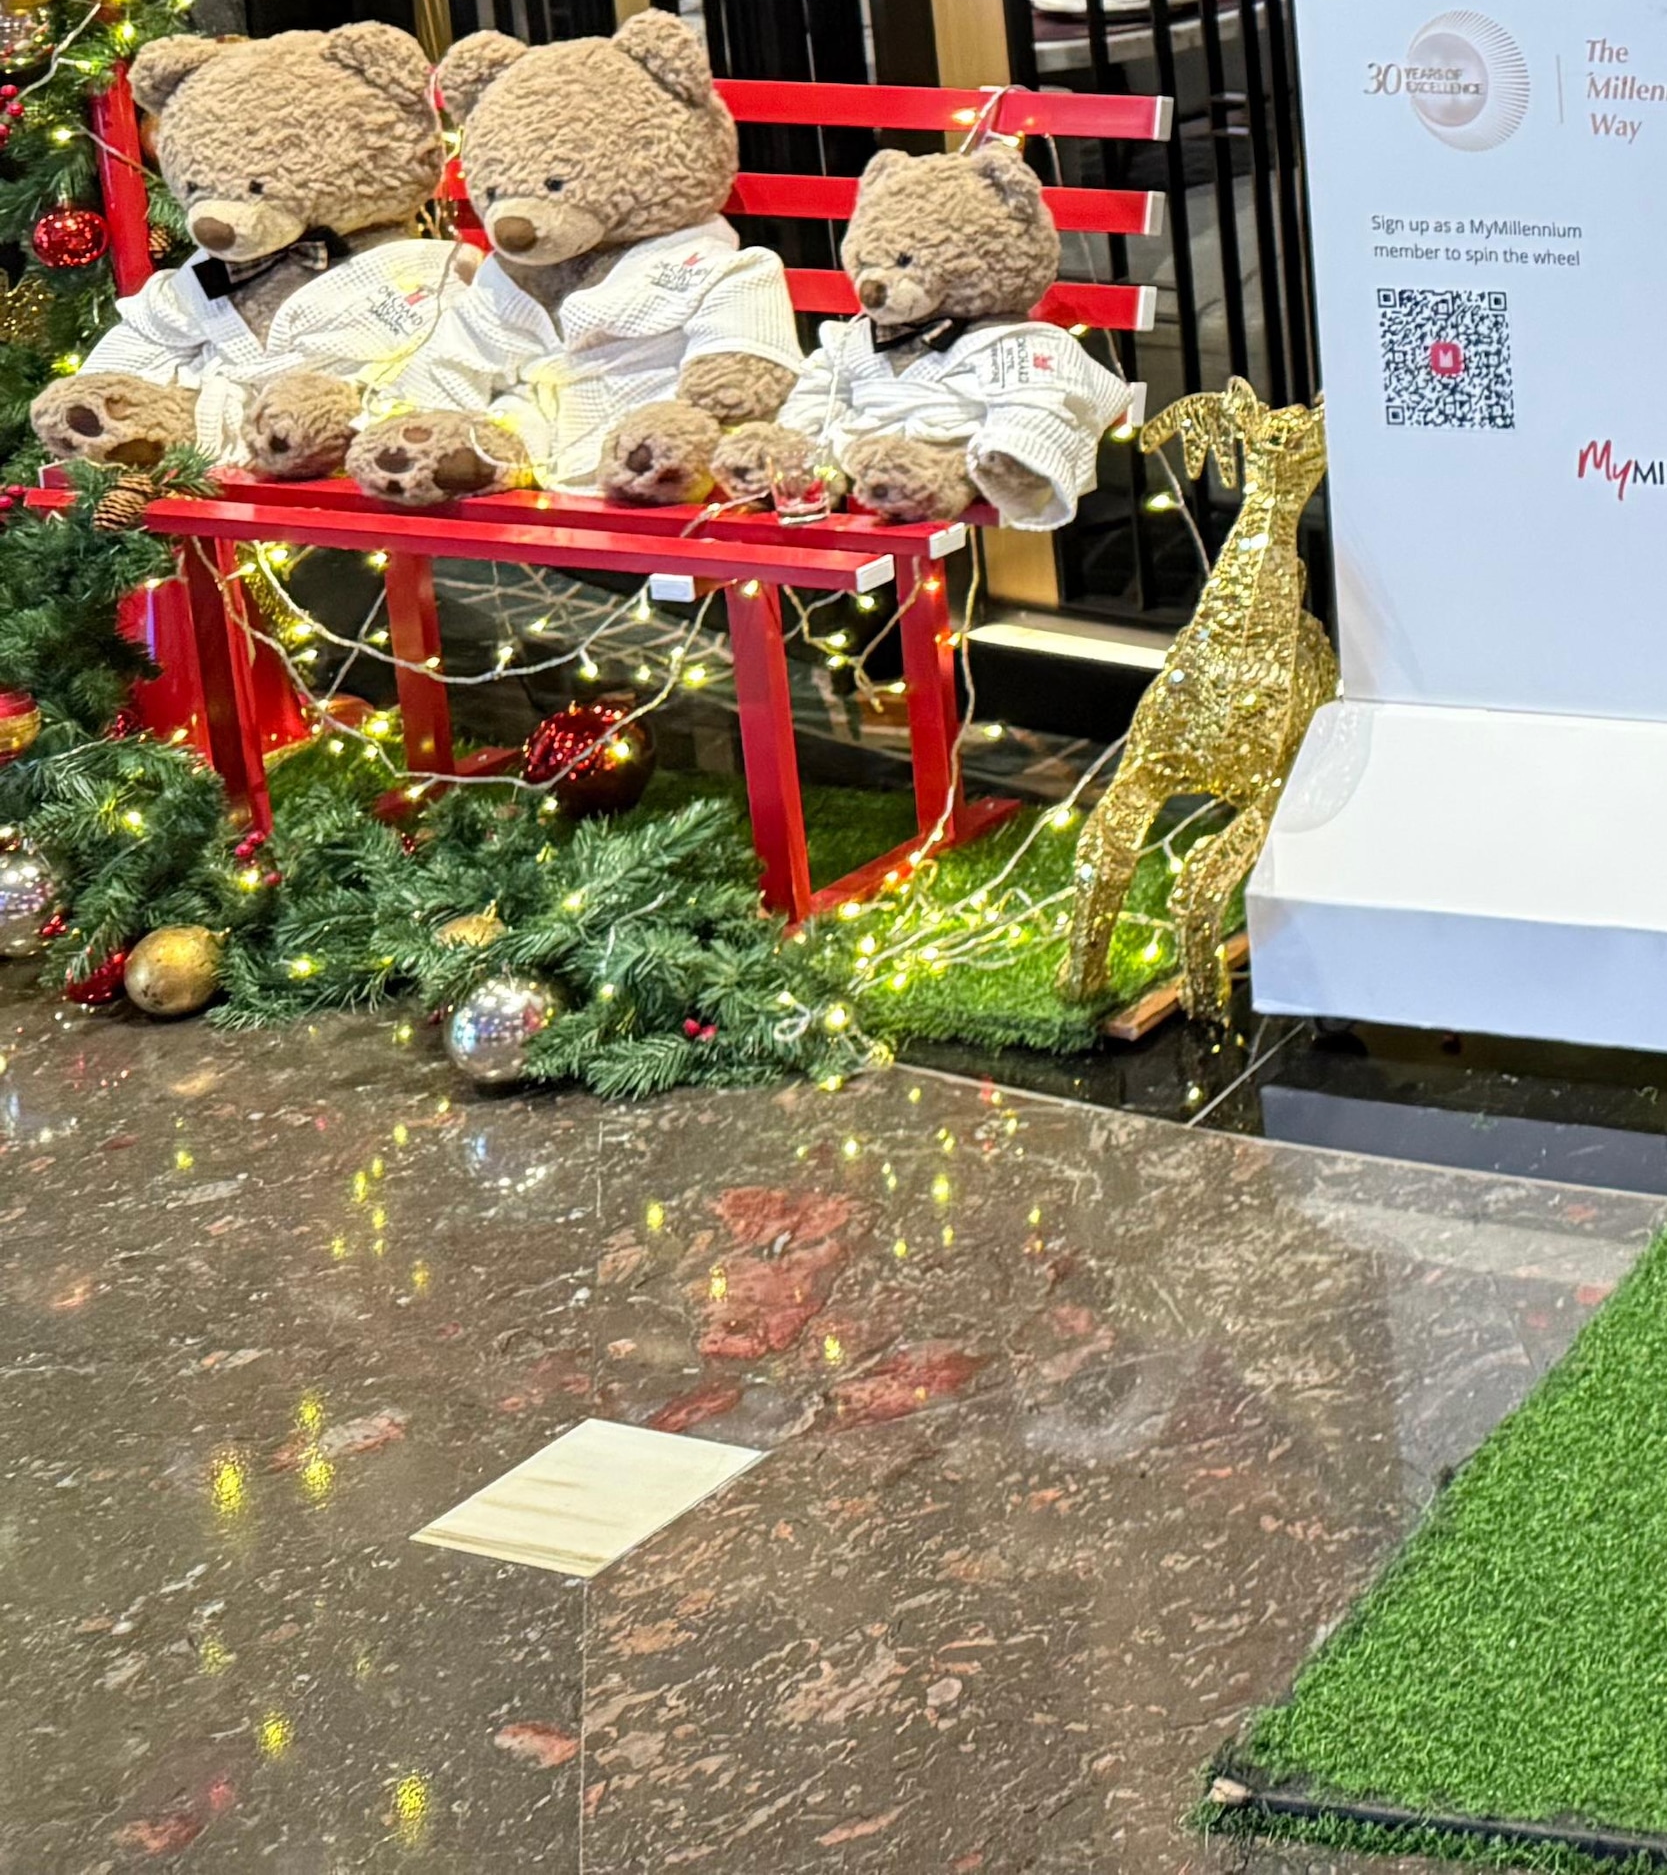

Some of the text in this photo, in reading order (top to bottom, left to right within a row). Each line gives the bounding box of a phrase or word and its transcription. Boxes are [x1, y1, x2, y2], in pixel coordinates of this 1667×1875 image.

[1586, 38, 1629, 65] The
[1363, 62, 1402, 96] 30
[1404, 67, 1444, 81] YEARS
[1591, 113, 1643, 144] Way
[1371, 215, 1583, 241] Sign up as a MyMillennium
[1373, 243, 1581, 267] member to spin the wheel
